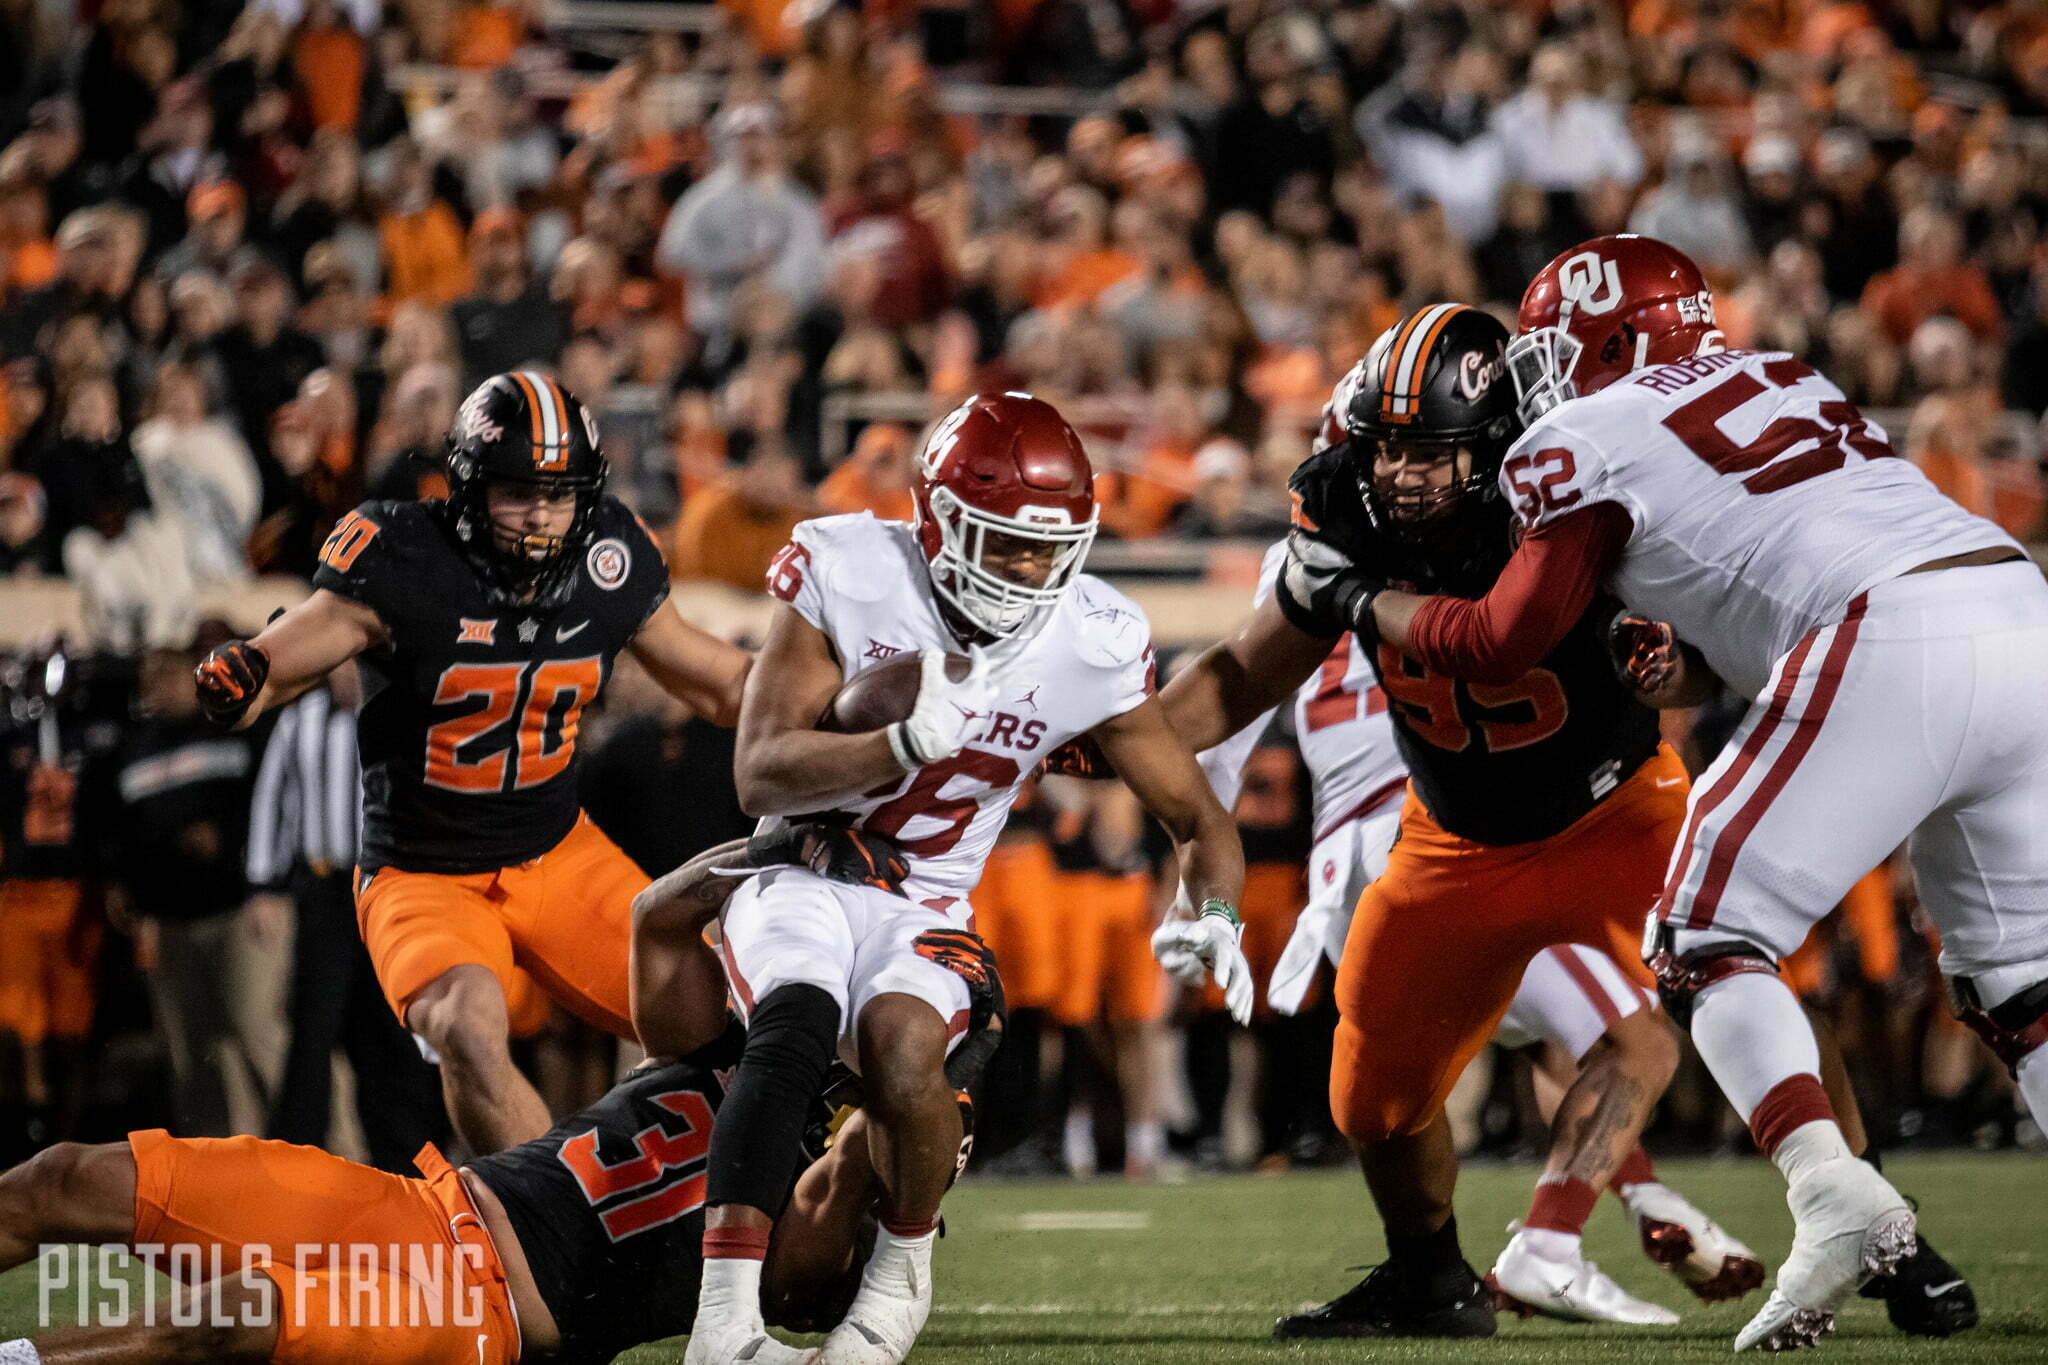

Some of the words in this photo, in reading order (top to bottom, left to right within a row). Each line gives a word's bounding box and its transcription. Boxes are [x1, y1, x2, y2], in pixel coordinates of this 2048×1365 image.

[1558, 251, 1624, 317] OU
[1660, 357, 1898, 496] 52
[1504, 446, 1584, 523] 52
[317, 509, 381, 575] 20
[423, 654, 602, 794] 20
[556, 1089, 716, 1245] 31
